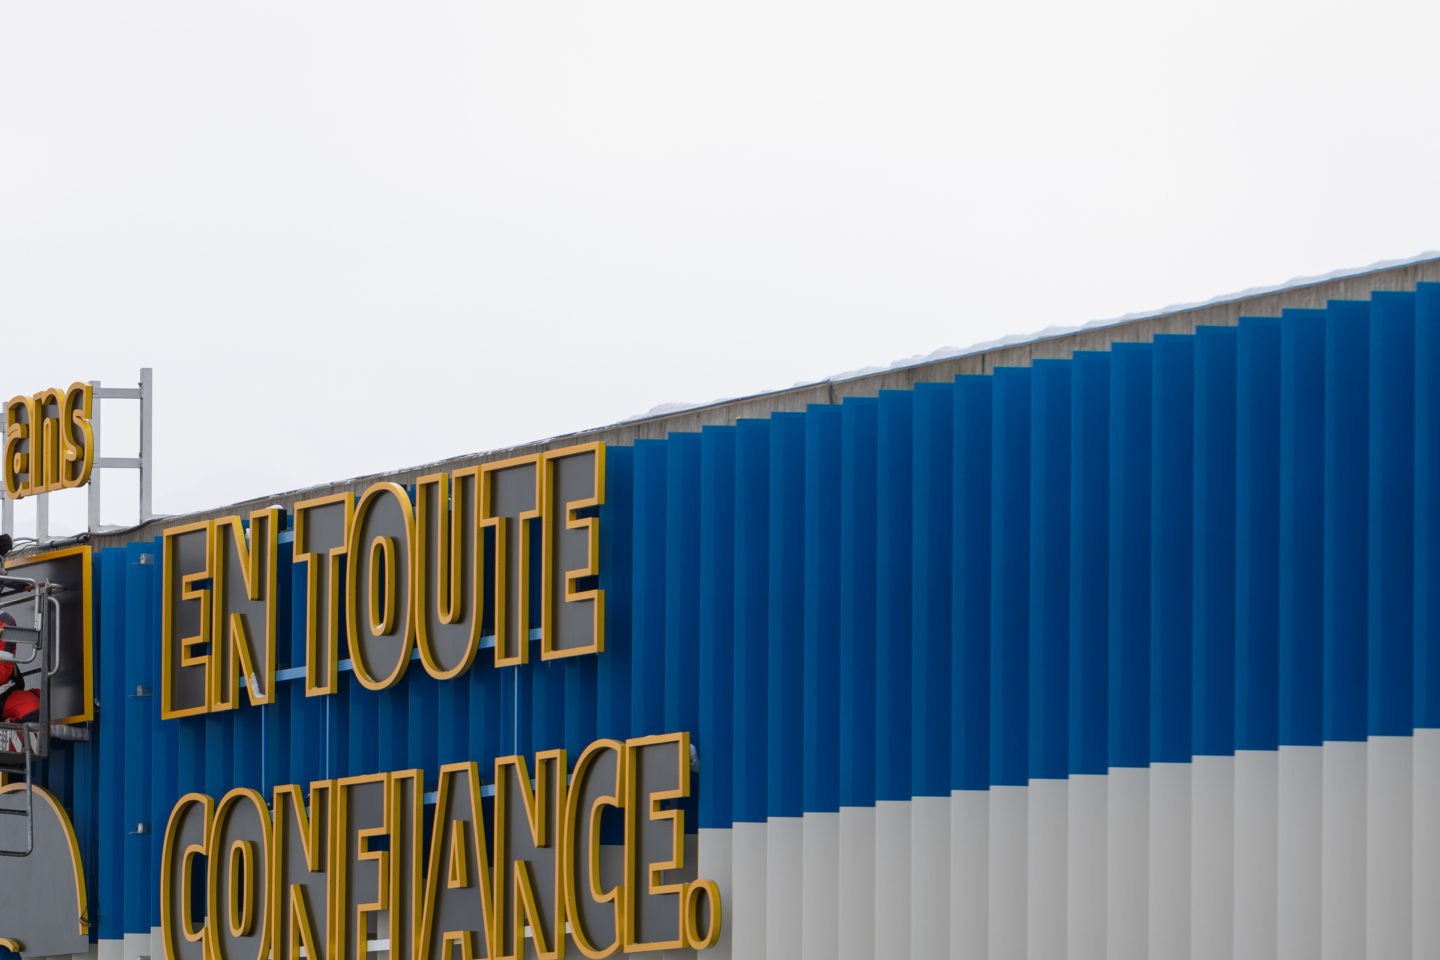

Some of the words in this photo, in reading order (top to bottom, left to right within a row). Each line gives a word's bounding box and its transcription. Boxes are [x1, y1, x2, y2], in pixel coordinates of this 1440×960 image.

[4, 381, 94, 500] ans
[161, 514, 278, 720] EN
[293, 441, 606, 698] TOUTE
